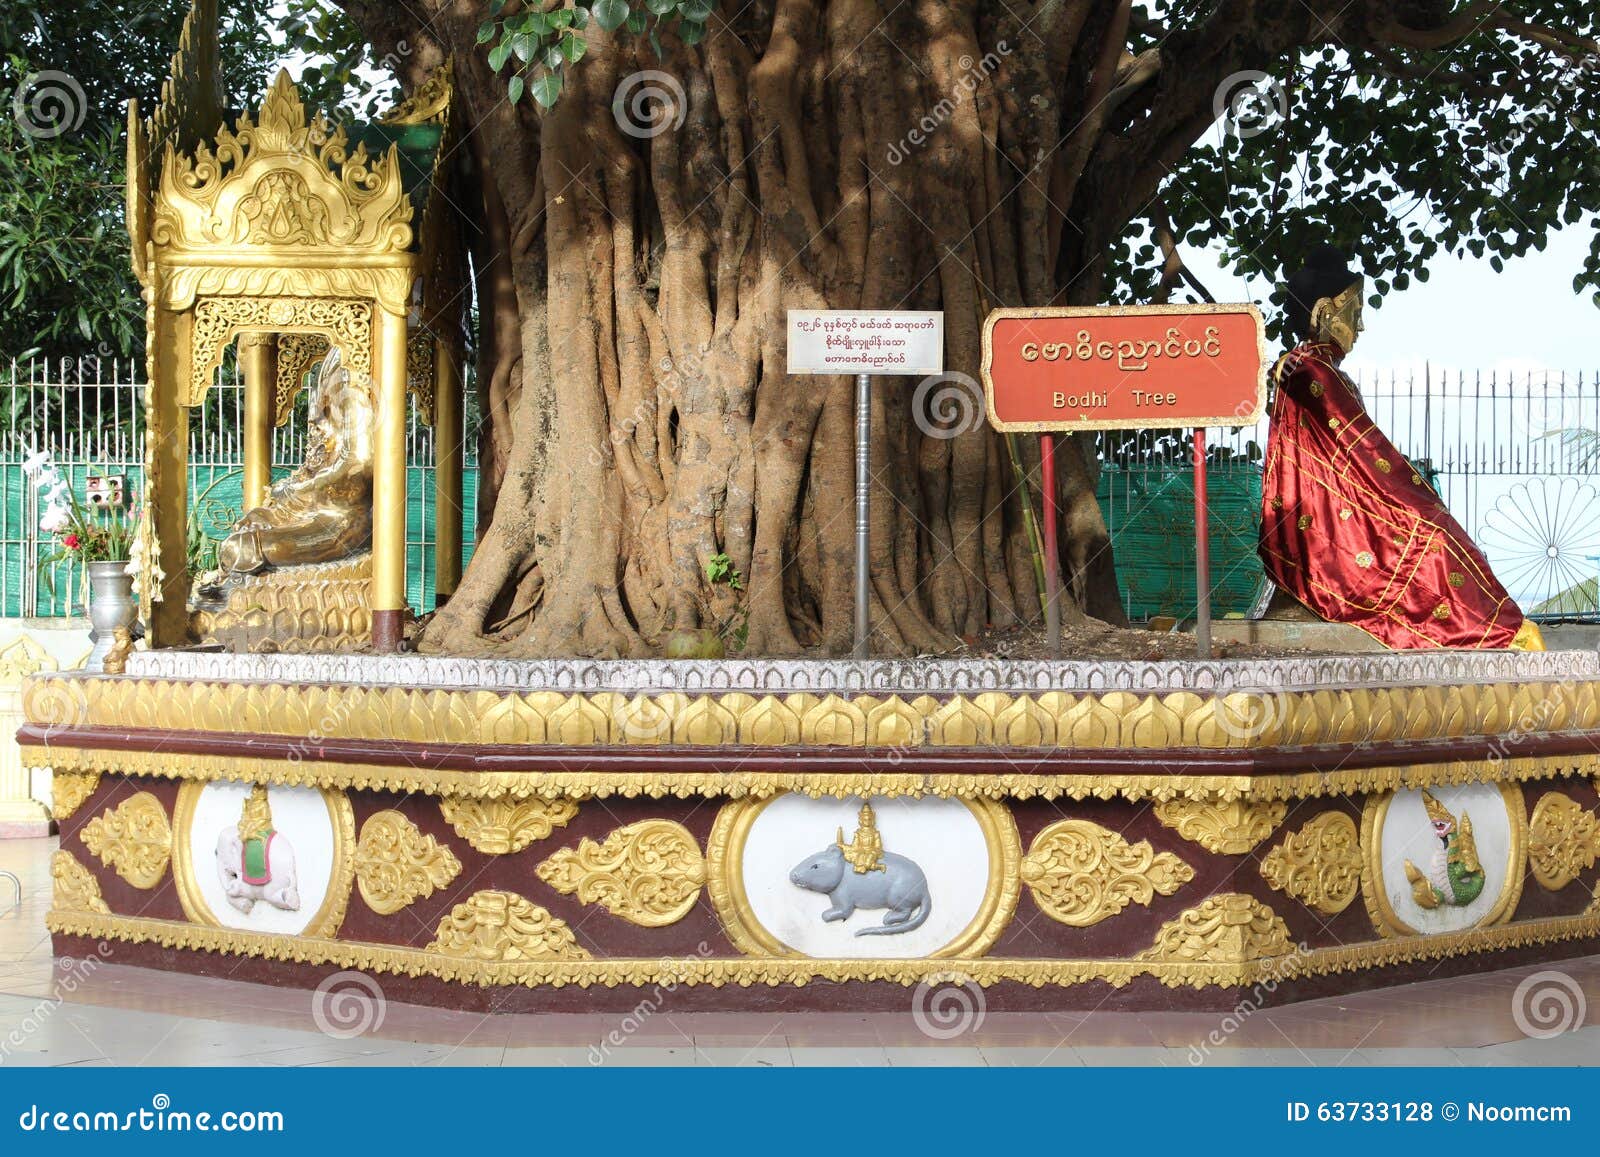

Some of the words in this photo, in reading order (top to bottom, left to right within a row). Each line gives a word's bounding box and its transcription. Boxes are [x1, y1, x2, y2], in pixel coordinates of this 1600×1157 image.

[1021, 326, 1221, 371] ဗောဓိညောင်ပင်
[1053, 390, 1108, 409] Bodhi
[1132, 389, 1178, 407] Tree
